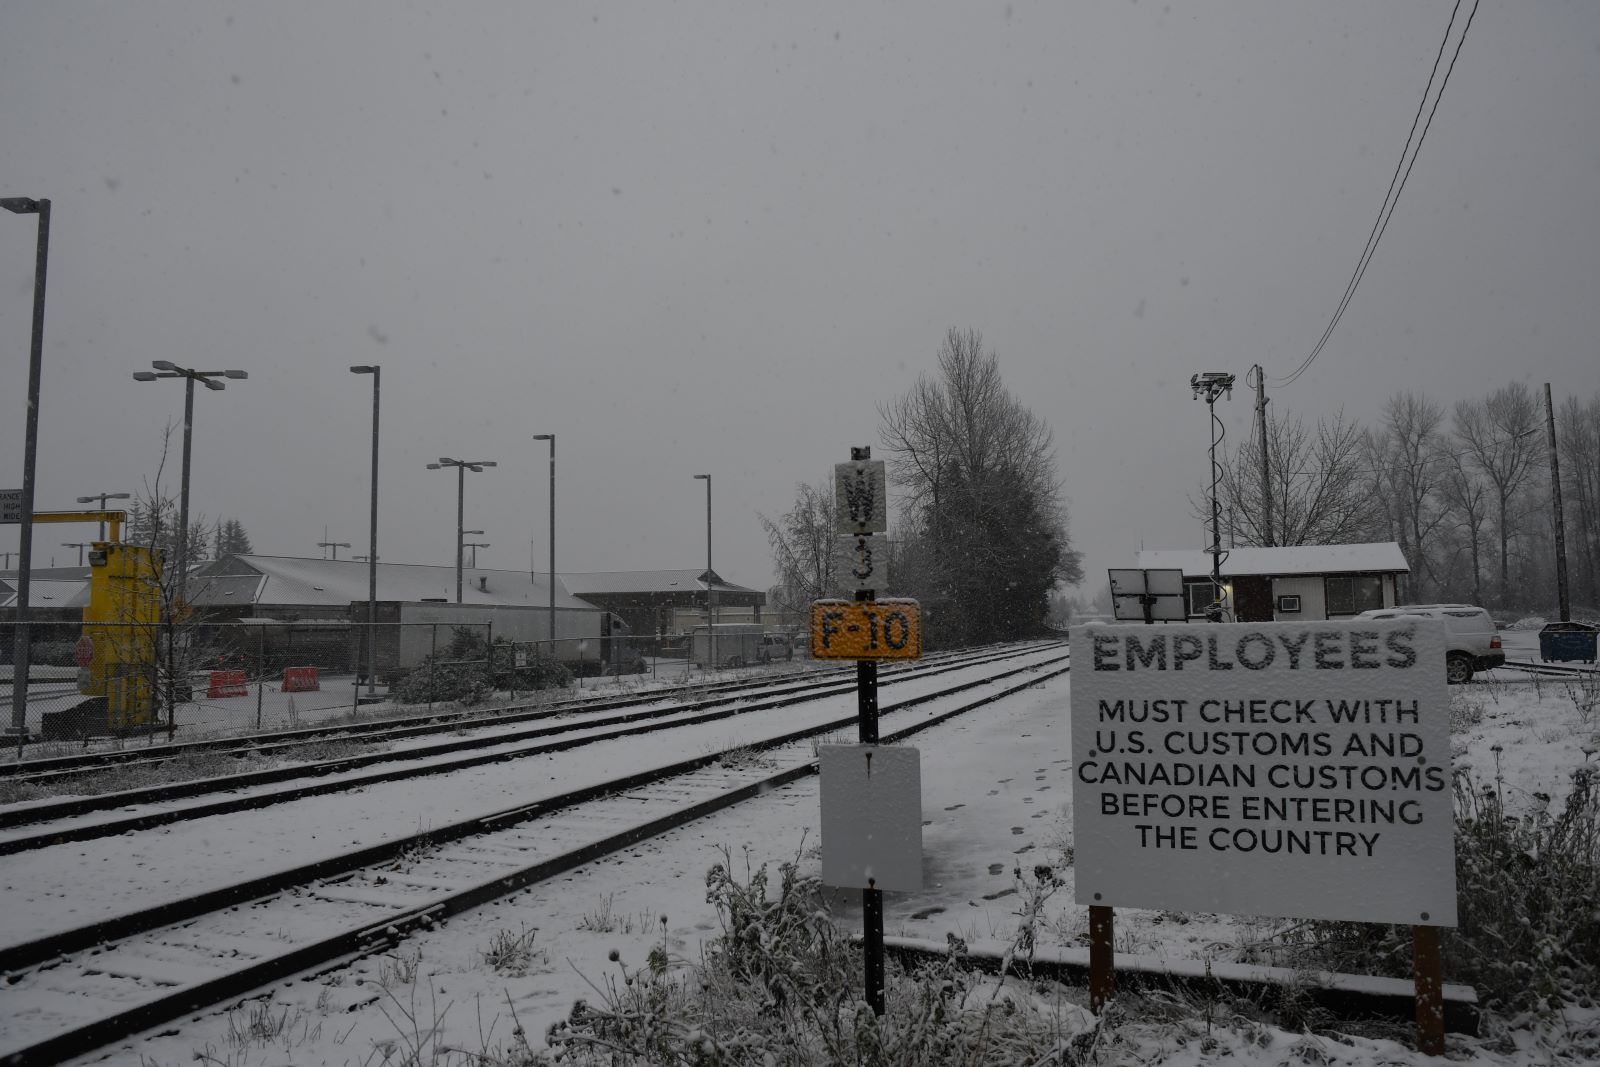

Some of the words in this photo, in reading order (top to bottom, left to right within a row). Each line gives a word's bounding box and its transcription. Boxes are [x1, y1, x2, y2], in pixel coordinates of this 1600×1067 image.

[851, 544, 874, 579] 3
[821, 610, 910, 651] F-10
[1093, 629, 1418, 672] EMPLOYEES
[1098, 698, 1188, 724] MUST
[1198, 698, 1317, 725] CHECK
[1325, 699, 1420, 725] WITH
[1096, 731, 1154, 755] U.S.
[1163, 731, 1333, 758] CUSTOMS
[1342, 733, 1425, 758] AND
[1078, 761, 1256, 789] CANADIAN
[1267, 764, 1446, 793] CUSTOMS
[1100, 792, 1231, 820] BEFORE
[1241, 796, 1425, 826] ENTERING
[1134, 824, 1199, 852] THE
[1208, 827, 1381, 857] COUNTRY
